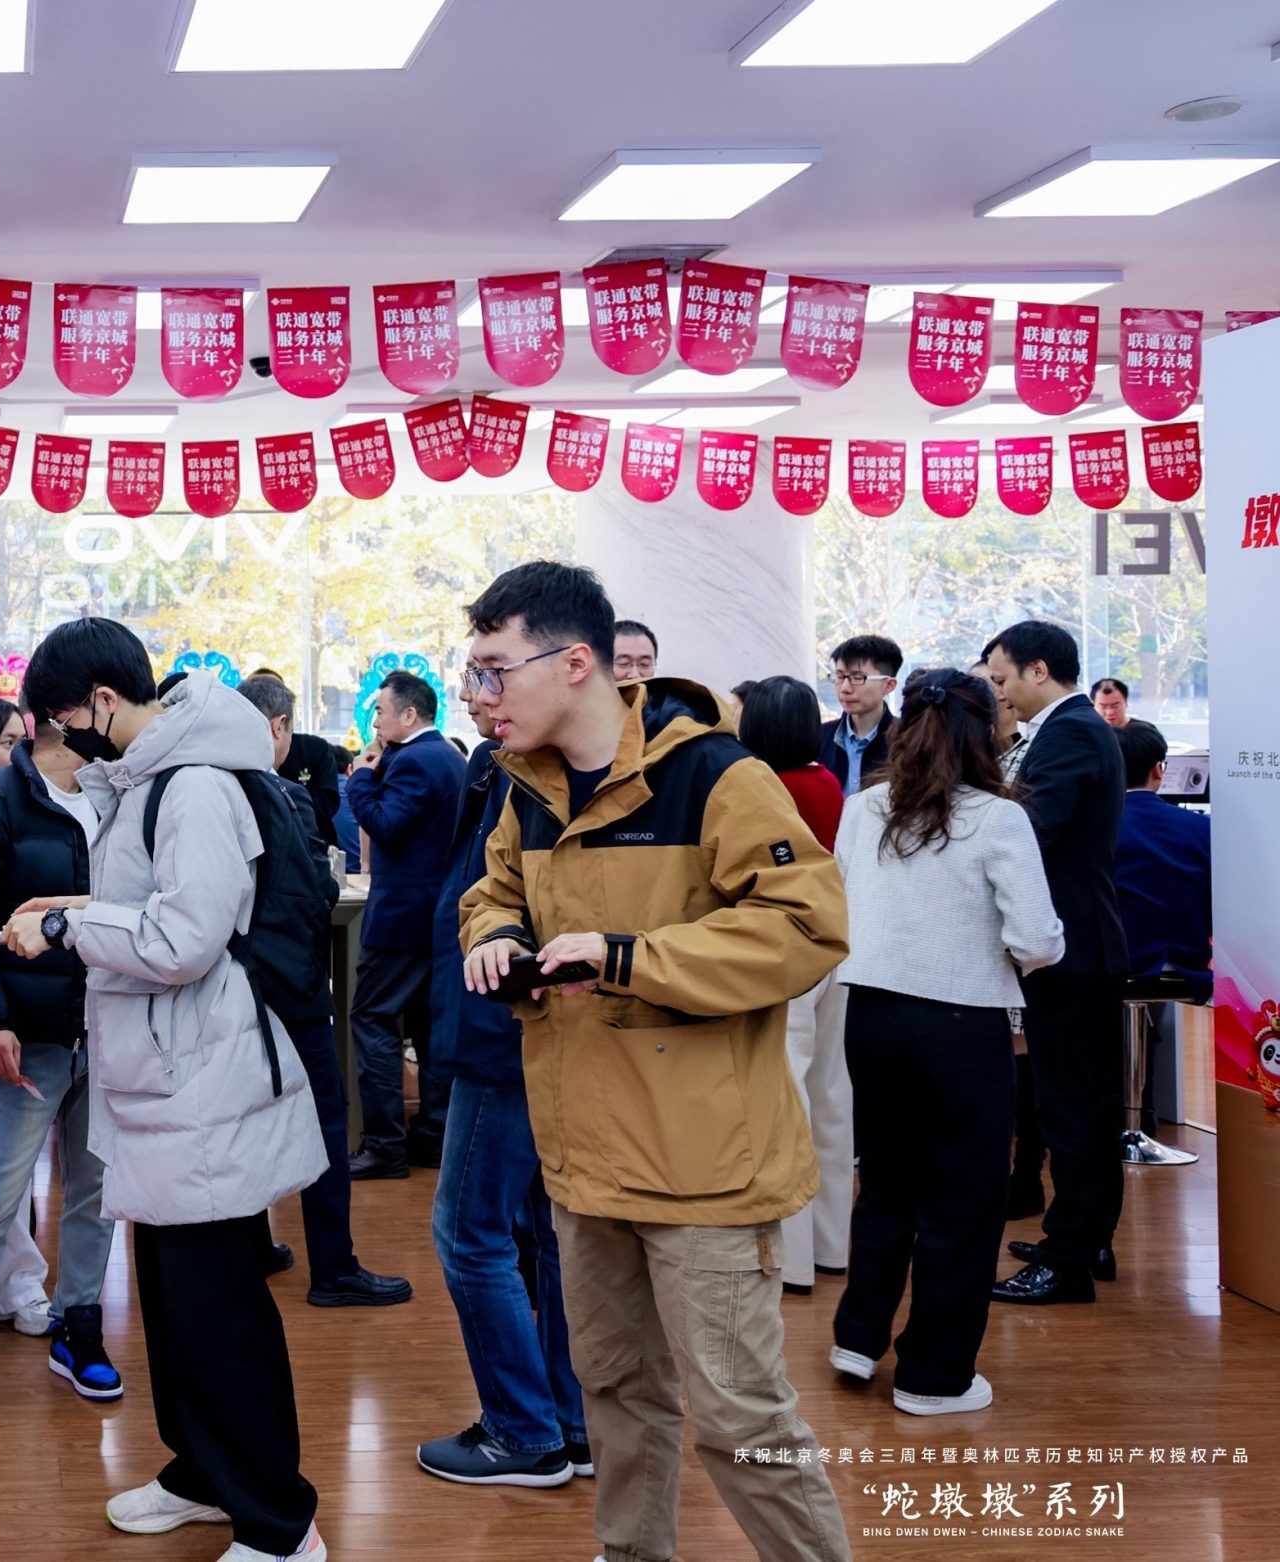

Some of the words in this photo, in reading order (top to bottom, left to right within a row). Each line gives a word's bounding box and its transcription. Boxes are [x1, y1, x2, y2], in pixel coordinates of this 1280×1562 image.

[593, 282, 659, 307] 联通宽带
[687, 284, 754, 308] 联通宽带
[488, 295, 554, 318] 联通宽带
[596, 301, 663, 325] 服务京城
[685, 302, 752, 327] 服务京城
[792, 300, 858, 324] 联通宽带
[61, 308, 129, 327] 联通宽带
[167, 311, 236, 329] 联通宽带
[276, 311, 341, 329] 联通宽带
[382, 305, 449, 326] 联通宽带
[384, 323, 451, 344] 服务京城
[490, 314, 557, 336] 服务京城
[599, 322, 648, 343] 三十年
[684, 322, 732, 343] 三十年
[789, 318, 856, 343] 服务京城
[917, 316, 984, 337] 联通宽带
[61, 326, 128, 346] 服务京城
[168, 330, 236, 348] 服务京城
[277, 329, 343, 347] 服务京城
[493, 334, 541, 354] 三十年
[1022, 325, 1090, 346] 联通宽带
[1127, 332, 1194, 351] 联通宽带
[387, 343, 435, 361] 三十年
[788, 338, 837, 358] 三十年
[916, 334, 983, 356] 服务京城
[61, 346, 110, 364] 三十年
[169, 349, 218, 366] 三十年
[279, 348, 326, 365] 三十年
[915, 353, 964, 372] 三十年
[1021, 344, 1088, 364] 服务京城
[1126, 350, 1193, 369] 服务京城
[1020, 363, 1069, 381] 三十年
[1126, 369, 1175, 387] 三十年
[412, 415, 459, 439] 联通宽带
[474, 413, 521, 432] 联通宽带
[416, 428, 464, 451] 服务京城
[471, 425, 519, 445] 服务京城
[555, 427, 603, 445] 联通宽带
[338, 434, 385, 454] 联通宽带
[469, 438, 504, 455] 三十年
[553, 440, 601, 459] 服务京城
[629, 438, 677, 455] 联通宽带
[1149, 437, 1194, 454] 联通宽带
[38, 450, 85, 466] 联通宽带
[262, 448, 309, 465] 联通宽带
[340, 447, 388, 467] 服务京城
[421, 444, 455, 463] 三十年
[552, 454, 587, 469] 三十年
[627, 451, 675, 468] 服务京城
[703, 447, 751, 462] 联通宽带
[778, 453, 826, 467] 联通宽带
[853, 456, 901, 468] 联通宽带
[1002, 452, 1047, 467] 联通宽带
[1075, 446, 1122, 462] 联通宽带
[1150, 450, 1197, 467] 服务京城
[36, 463, 83, 479] 服务京城
[112, 456, 160, 470] 联通宽带
[187, 456, 234, 470] 联通宽带
[263, 461, 311, 478] 服务京城
[343, 462, 378, 479] 三十年
[702, 460, 750, 475] 服务京城
[927, 456, 974, 469] 联通宽带
[1076, 459, 1124, 475] 服务京城
[112, 469, 159, 483] 服务京城
[188, 469, 235, 482] 服务京城
[626, 464, 662, 479] 三十年
[702, 473, 737, 487] 三十年
[778, 465, 825, 480] 服务京城
[853, 468, 901, 481] 服务京城
[928, 469, 974, 482] 服务京城
[1002, 465, 1049, 479] 服务京城
[1078, 473, 1113, 487] 三十年
[1152, 465, 1186, 479] 三十年
[36, 476, 70, 490] 三十年
[112, 482, 146, 495] 三十年
[189, 482, 223, 495] 三十年
[266, 475, 300, 490] 三十年
[778, 479, 813, 492] 三十年
[854, 481, 888, 494] 三十年
[929, 482, 963, 494] 三十年
[1004, 479, 1037, 492] 三十年
[1238, 751, 1280, 767] 庆祝北
[1227, 769, 1251, 779] Launch
[1253, 770, 1260, 779] of
[1262, 771, 1274, 780] the
[613, 831, 655, 841] TOREAD
